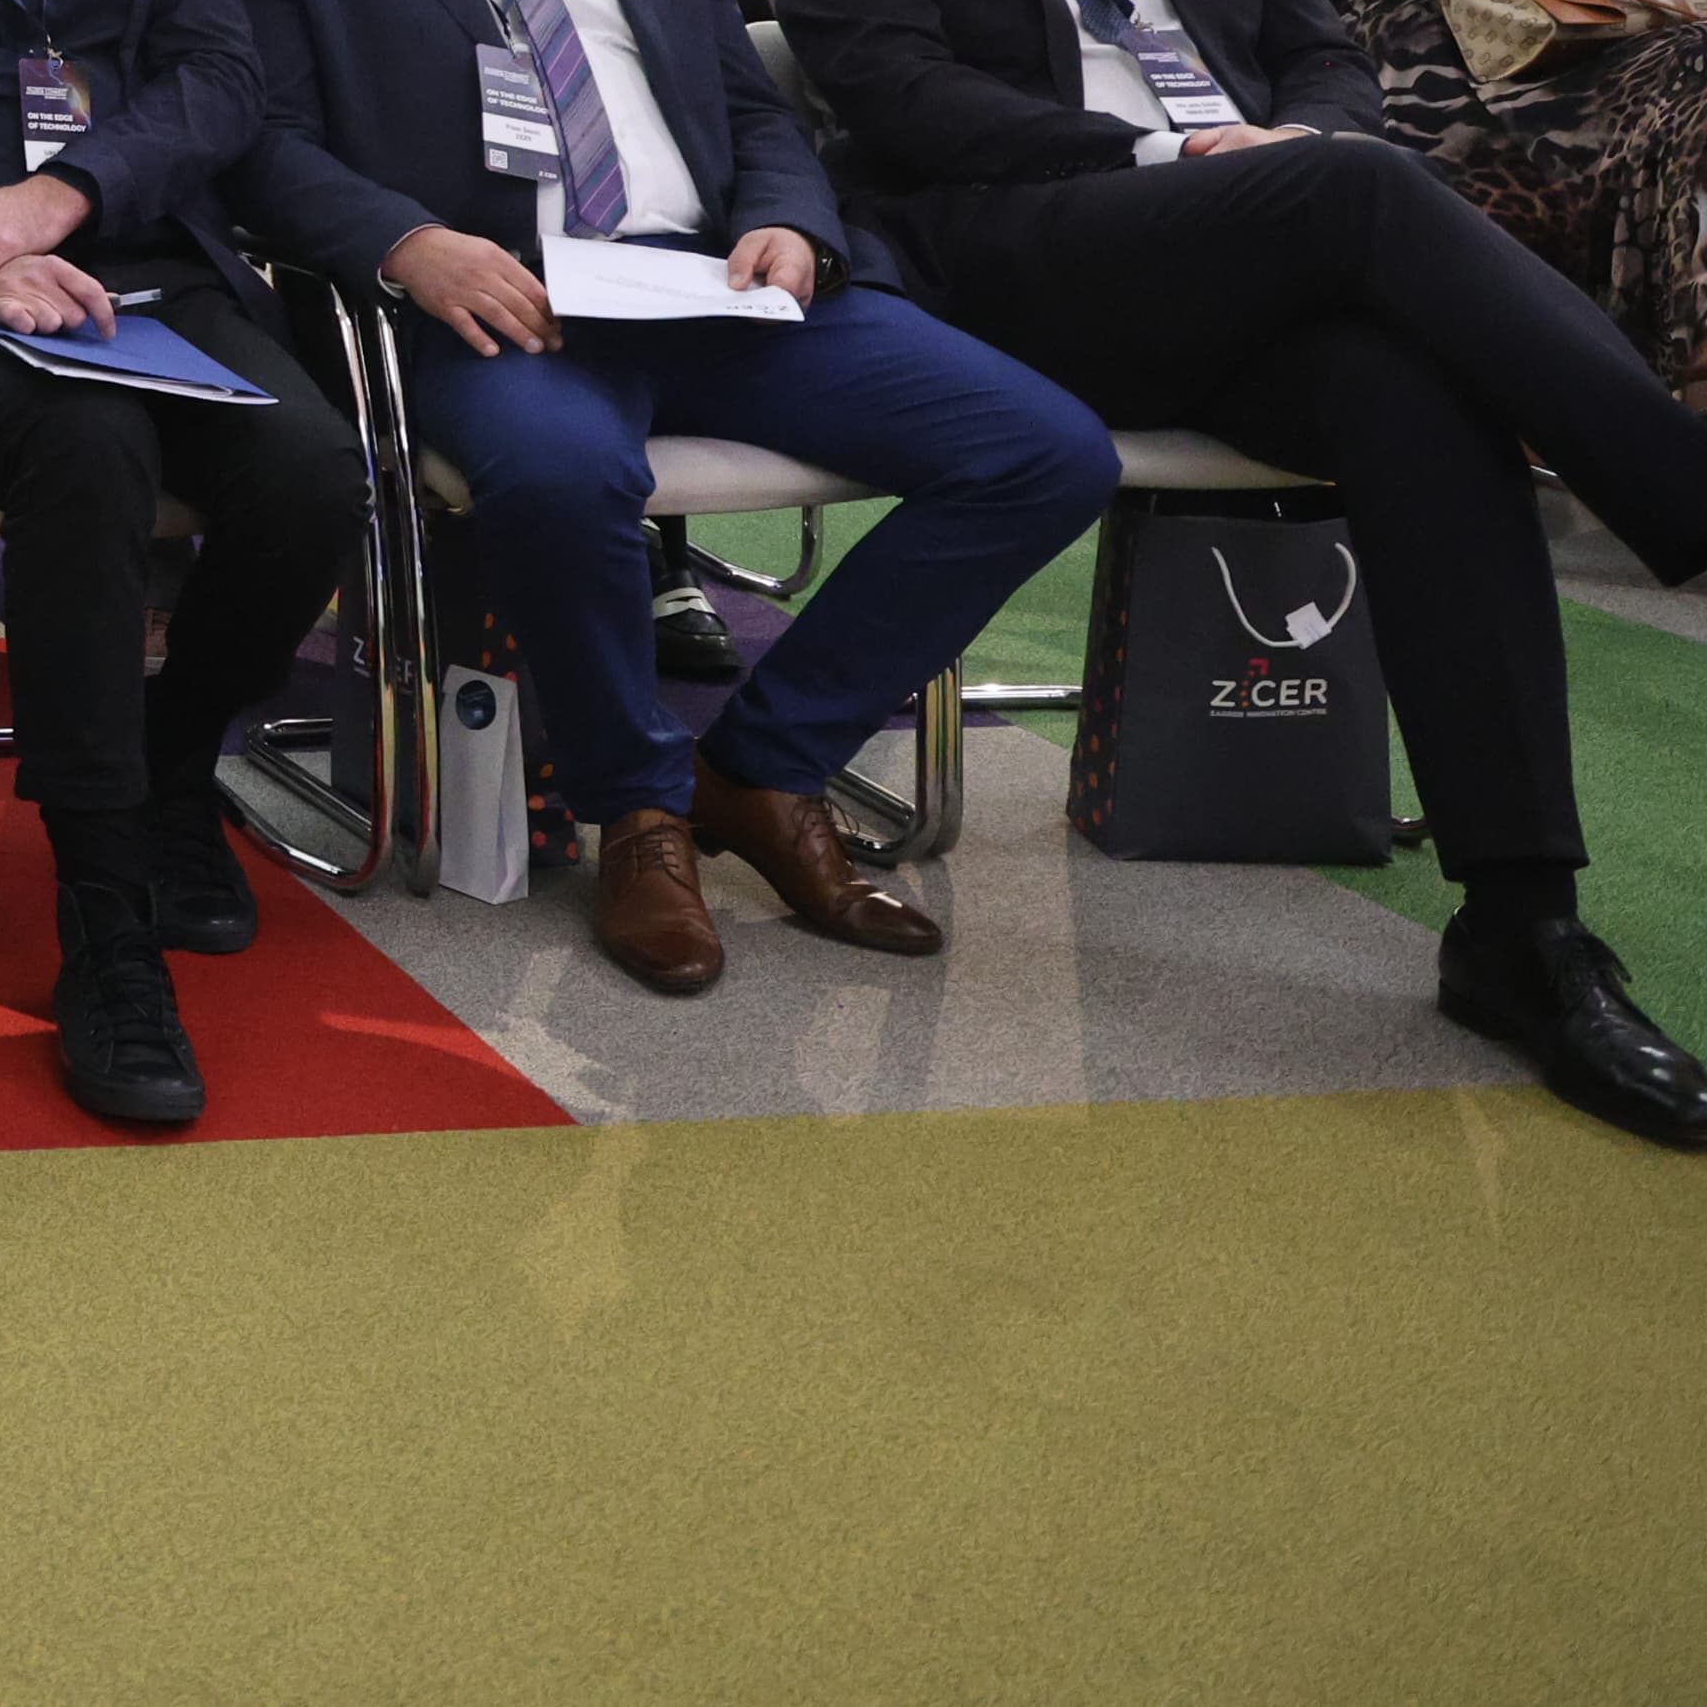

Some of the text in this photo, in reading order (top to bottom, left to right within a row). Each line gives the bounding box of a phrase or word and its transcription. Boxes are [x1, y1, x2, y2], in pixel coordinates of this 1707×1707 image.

[40, 112, 53, 120] THE
[54, 113, 72, 121] EDGE
[39, 122, 85, 131] TECHNOLOGY
